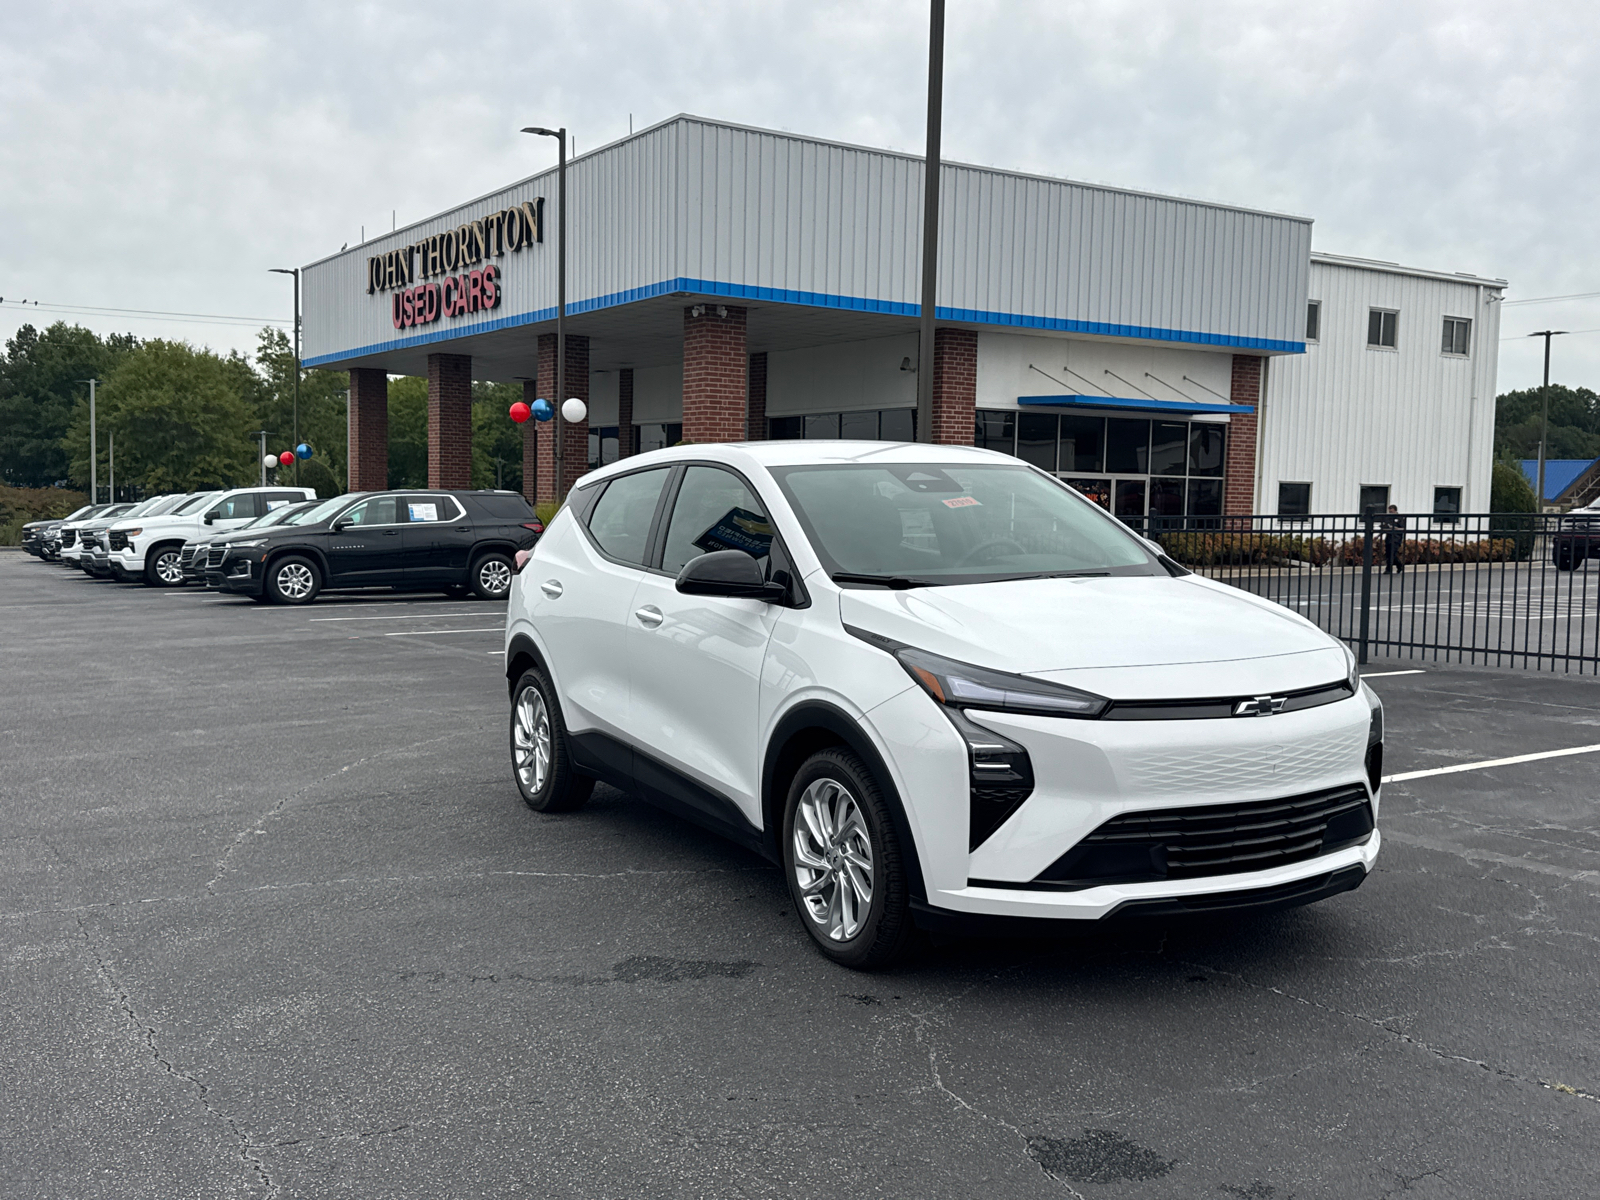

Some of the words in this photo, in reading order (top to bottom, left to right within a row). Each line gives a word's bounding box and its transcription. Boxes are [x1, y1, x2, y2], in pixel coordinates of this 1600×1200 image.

[366, 245, 415, 295] JOHN
[416, 197, 545, 279] THORNTON
[392, 283, 441, 329] USED
[442, 265, 501, 318] CARS
